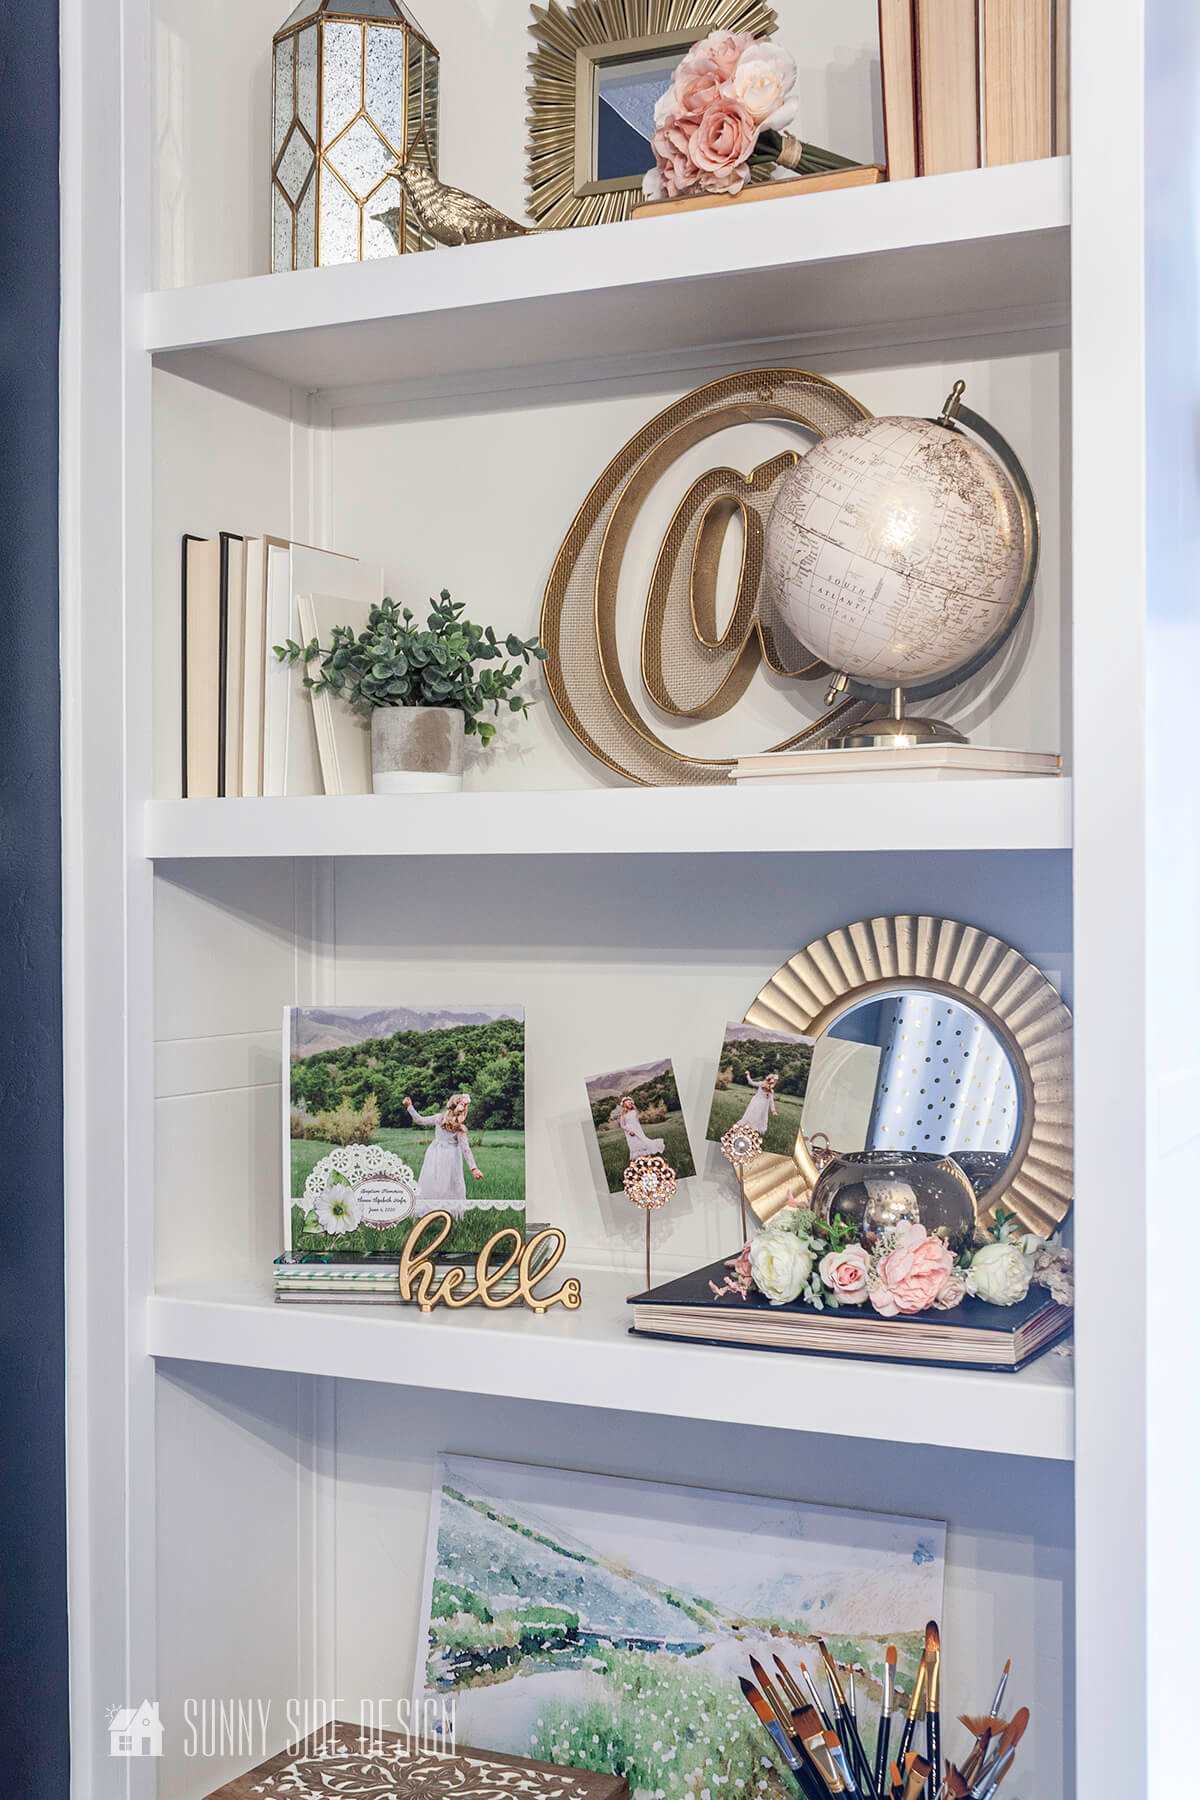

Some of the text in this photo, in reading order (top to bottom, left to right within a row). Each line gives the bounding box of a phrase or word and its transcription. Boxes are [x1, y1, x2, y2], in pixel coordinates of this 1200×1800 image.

[828, 575, 865, 594] SOUTH
[817, 587, 875, 615] ATLANTIC
[819, 603, 855, 623] OCEAN
